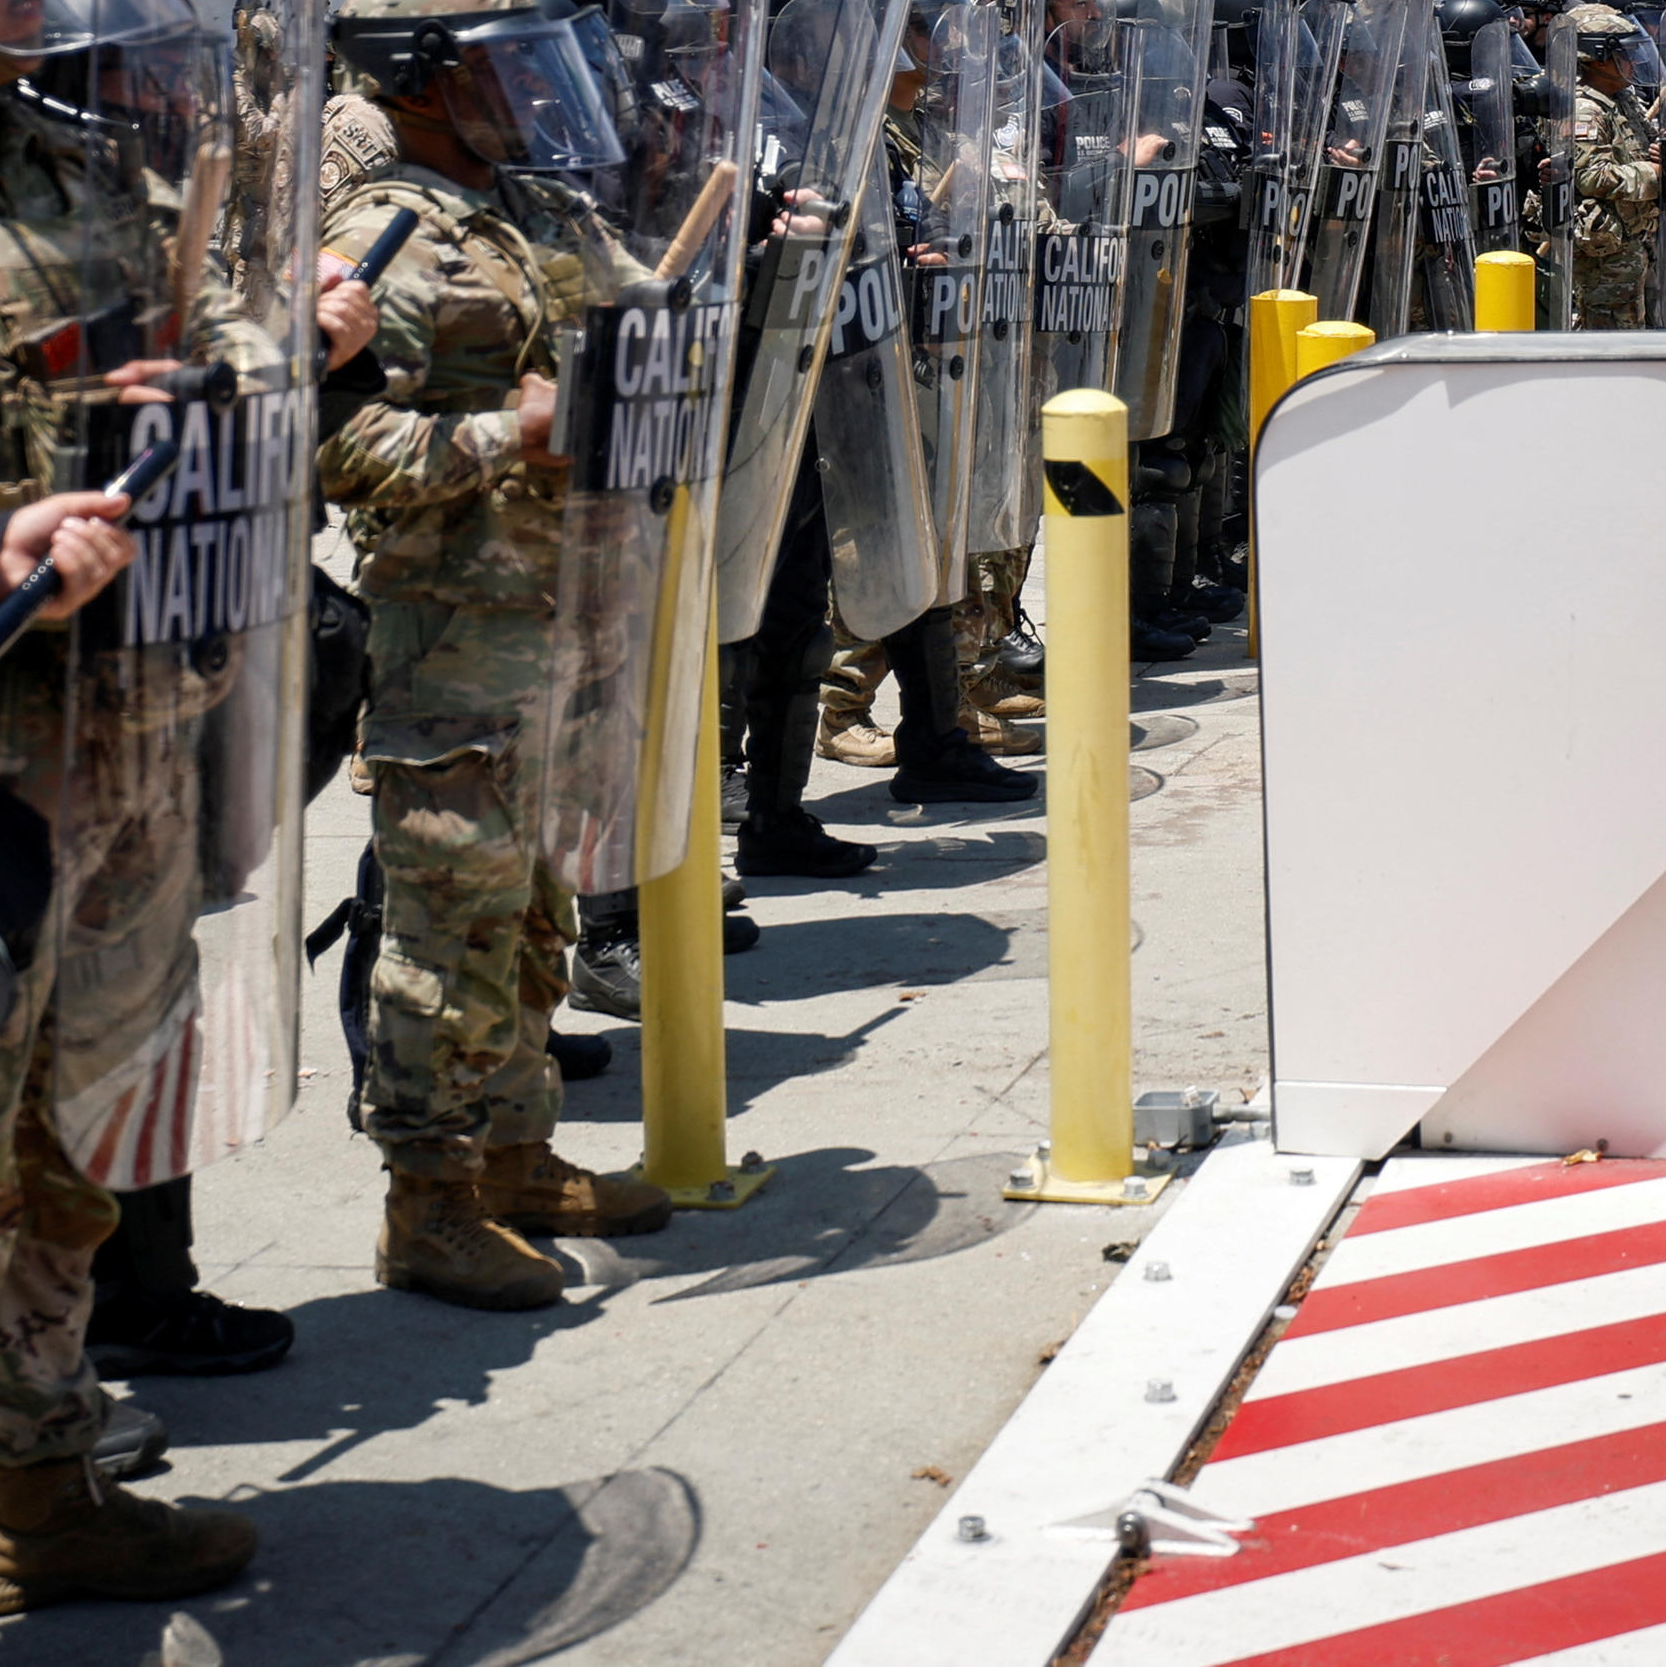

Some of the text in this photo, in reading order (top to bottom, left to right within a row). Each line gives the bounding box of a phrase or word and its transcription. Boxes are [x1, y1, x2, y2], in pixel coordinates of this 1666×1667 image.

[343, 124, 378, 154] SRT
[1075, 135, 1111, 150] POLICE
[931, 273, 976, 335] PO
